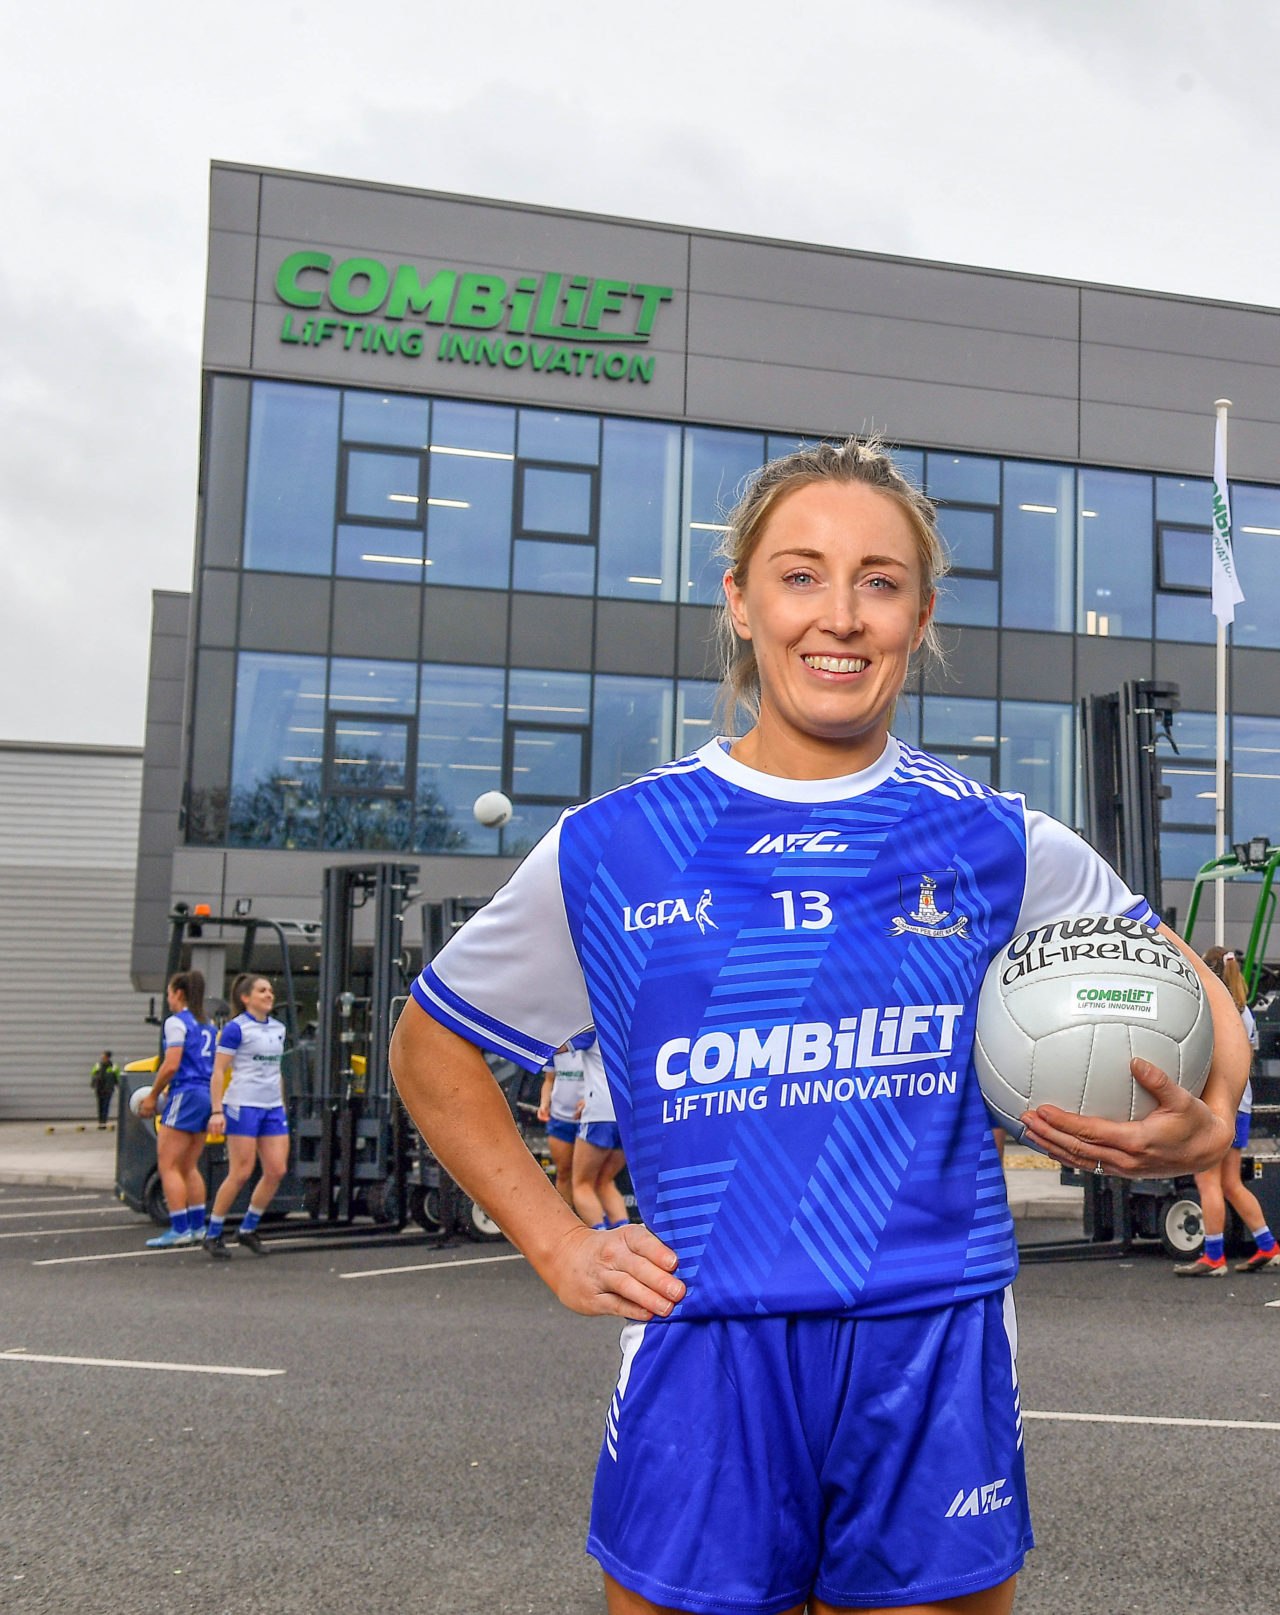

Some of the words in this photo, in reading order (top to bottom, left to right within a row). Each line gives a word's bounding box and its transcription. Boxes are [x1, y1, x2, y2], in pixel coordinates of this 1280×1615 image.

[437, 332, 656, 384] INNOVATION
[623, 898, 694, 932] LGFA
[771, 890, 834, 930] 13
[1108, 1003, 1151, 1013] INNOVATION
[201, 1029, 212, 1058] 2
[780, 1070, 957, 1107] INNOVATION
